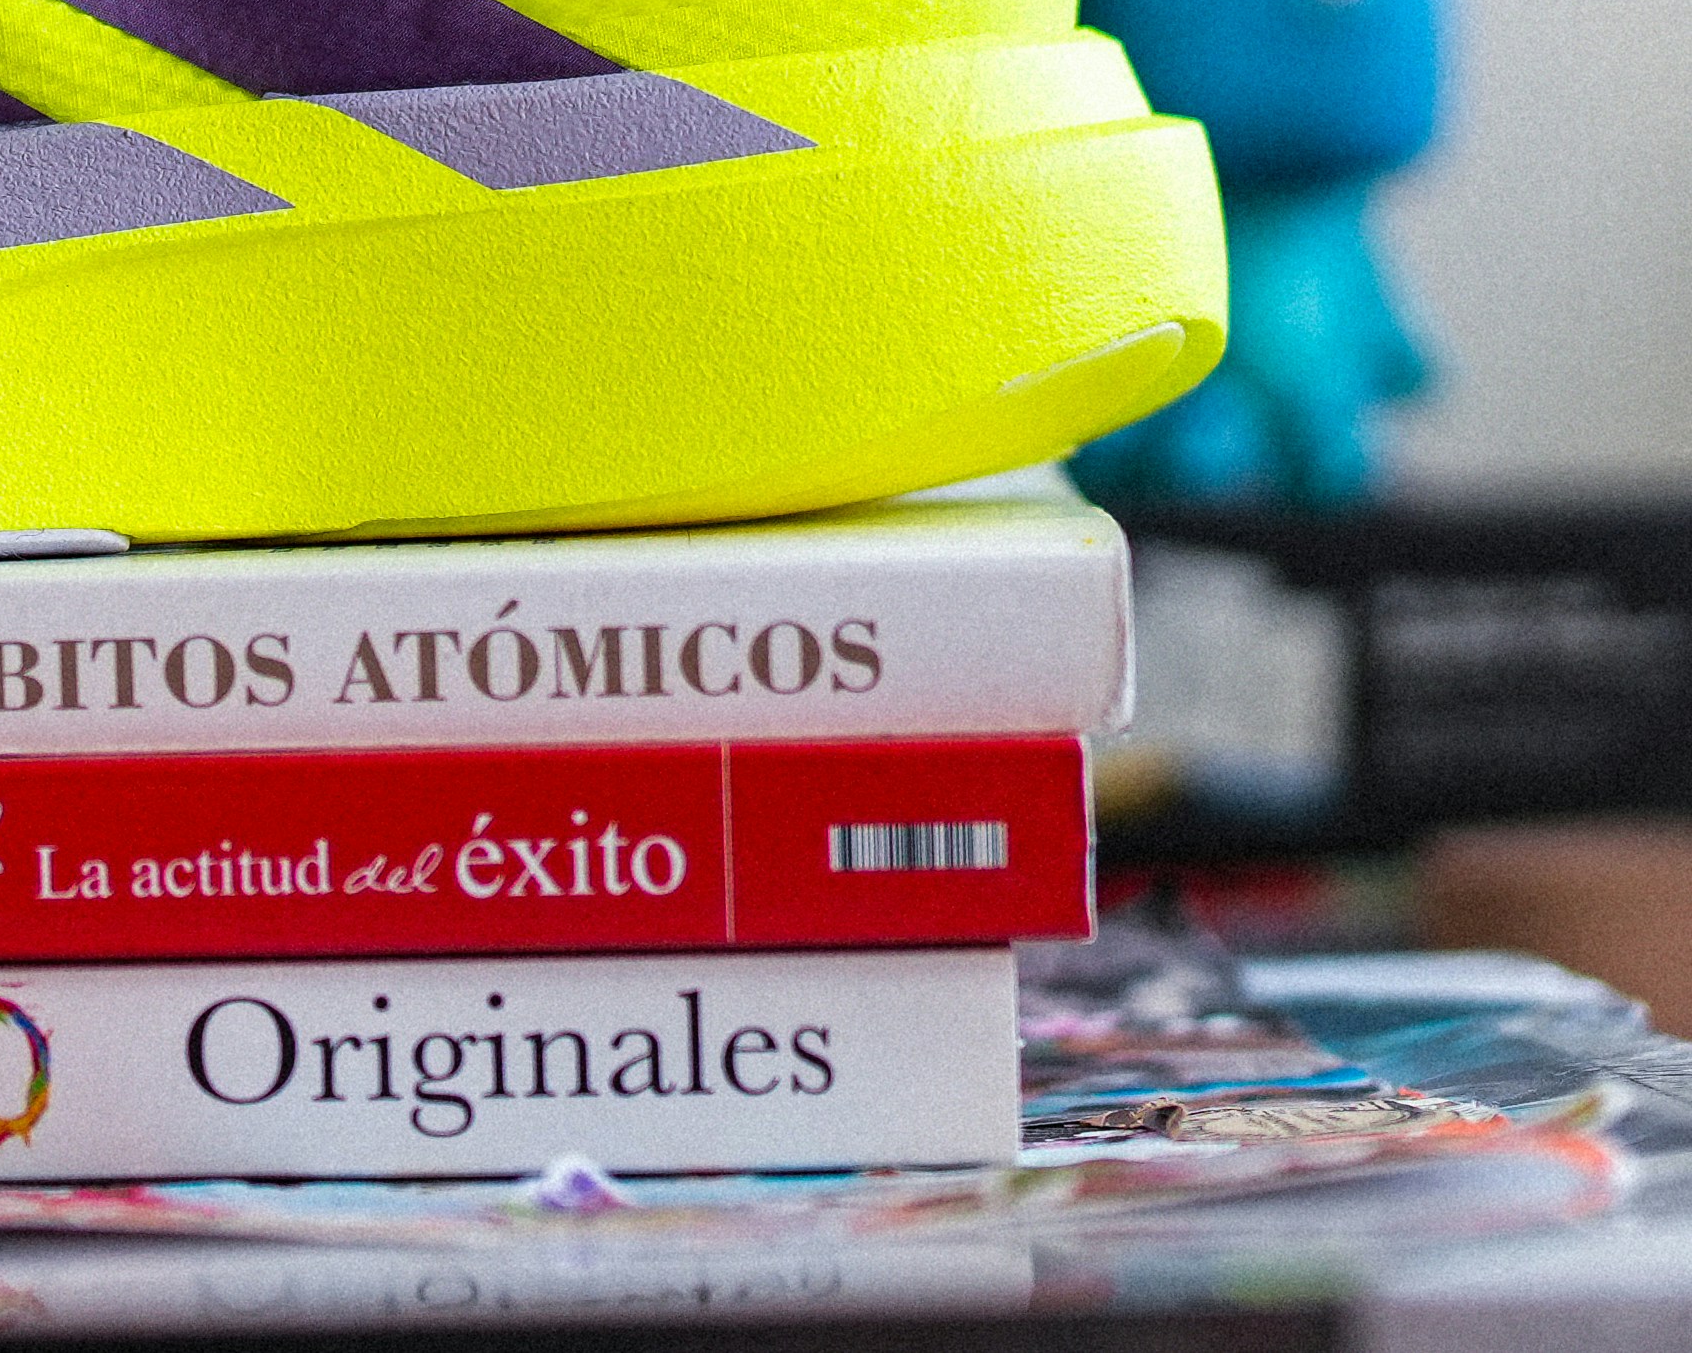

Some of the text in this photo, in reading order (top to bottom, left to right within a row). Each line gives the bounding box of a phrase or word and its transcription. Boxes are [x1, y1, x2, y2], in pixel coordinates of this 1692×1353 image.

[331, 598, 883, 705] ATÓMICOS
[35, 811, 688, 900] La actitud del éxito
[184, 989, 838, 1138] Originales
